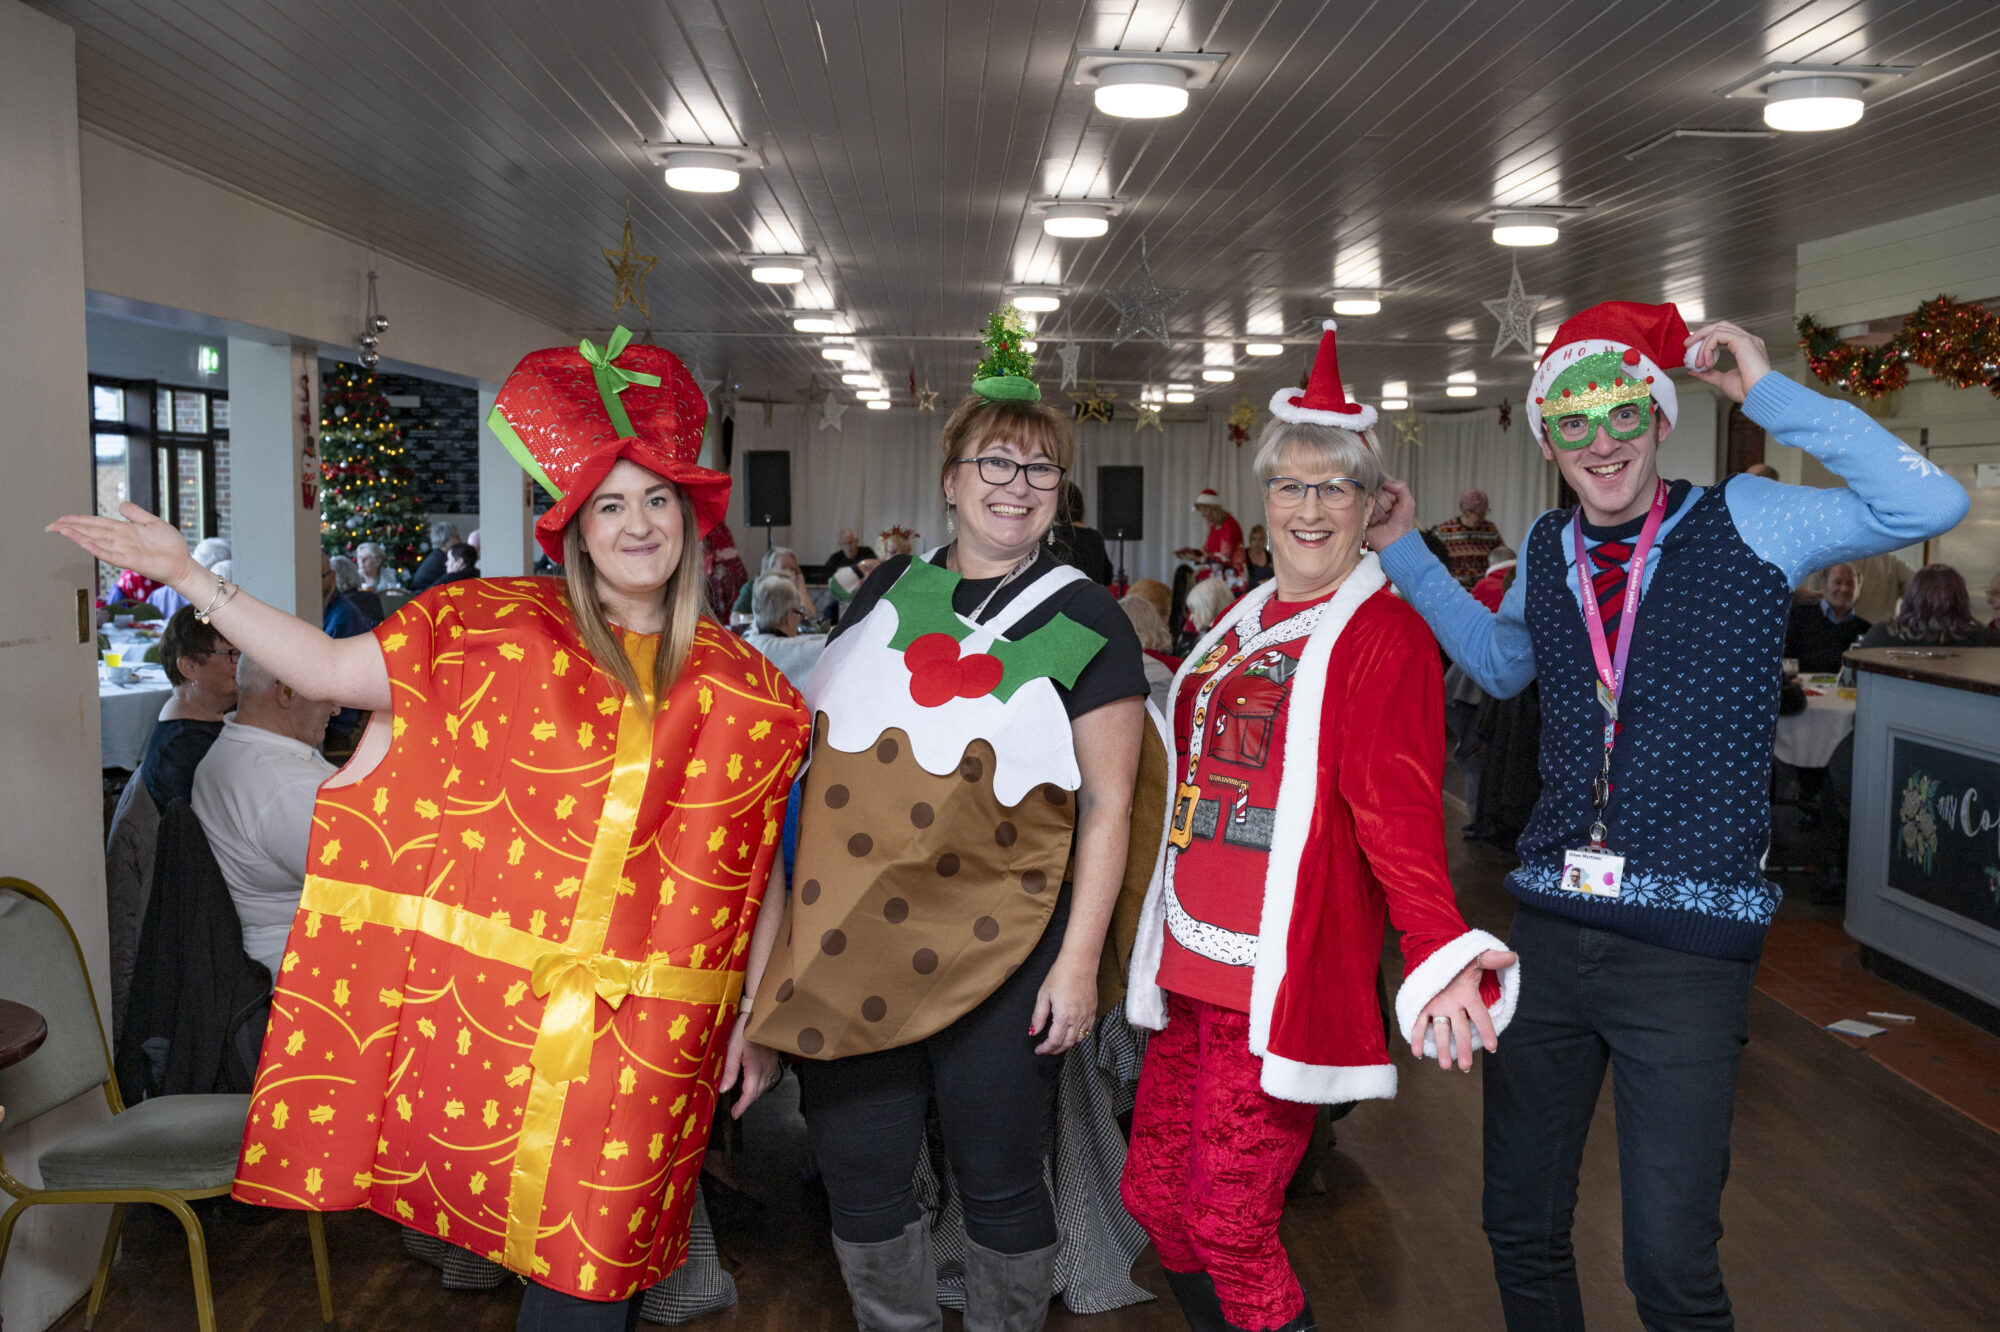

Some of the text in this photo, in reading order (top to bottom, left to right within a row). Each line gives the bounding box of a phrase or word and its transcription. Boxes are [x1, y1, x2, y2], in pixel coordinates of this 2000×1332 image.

[1563, 347, 1586, 360] HO
[1580, 563, 1589, 585] jabbed
[1630, 568, 1640, 590] double
[1583, 584, 1593, 605] double
[1626, 590, 1636, 613] jabbed
[1961, 787, 2000, 858] Co
